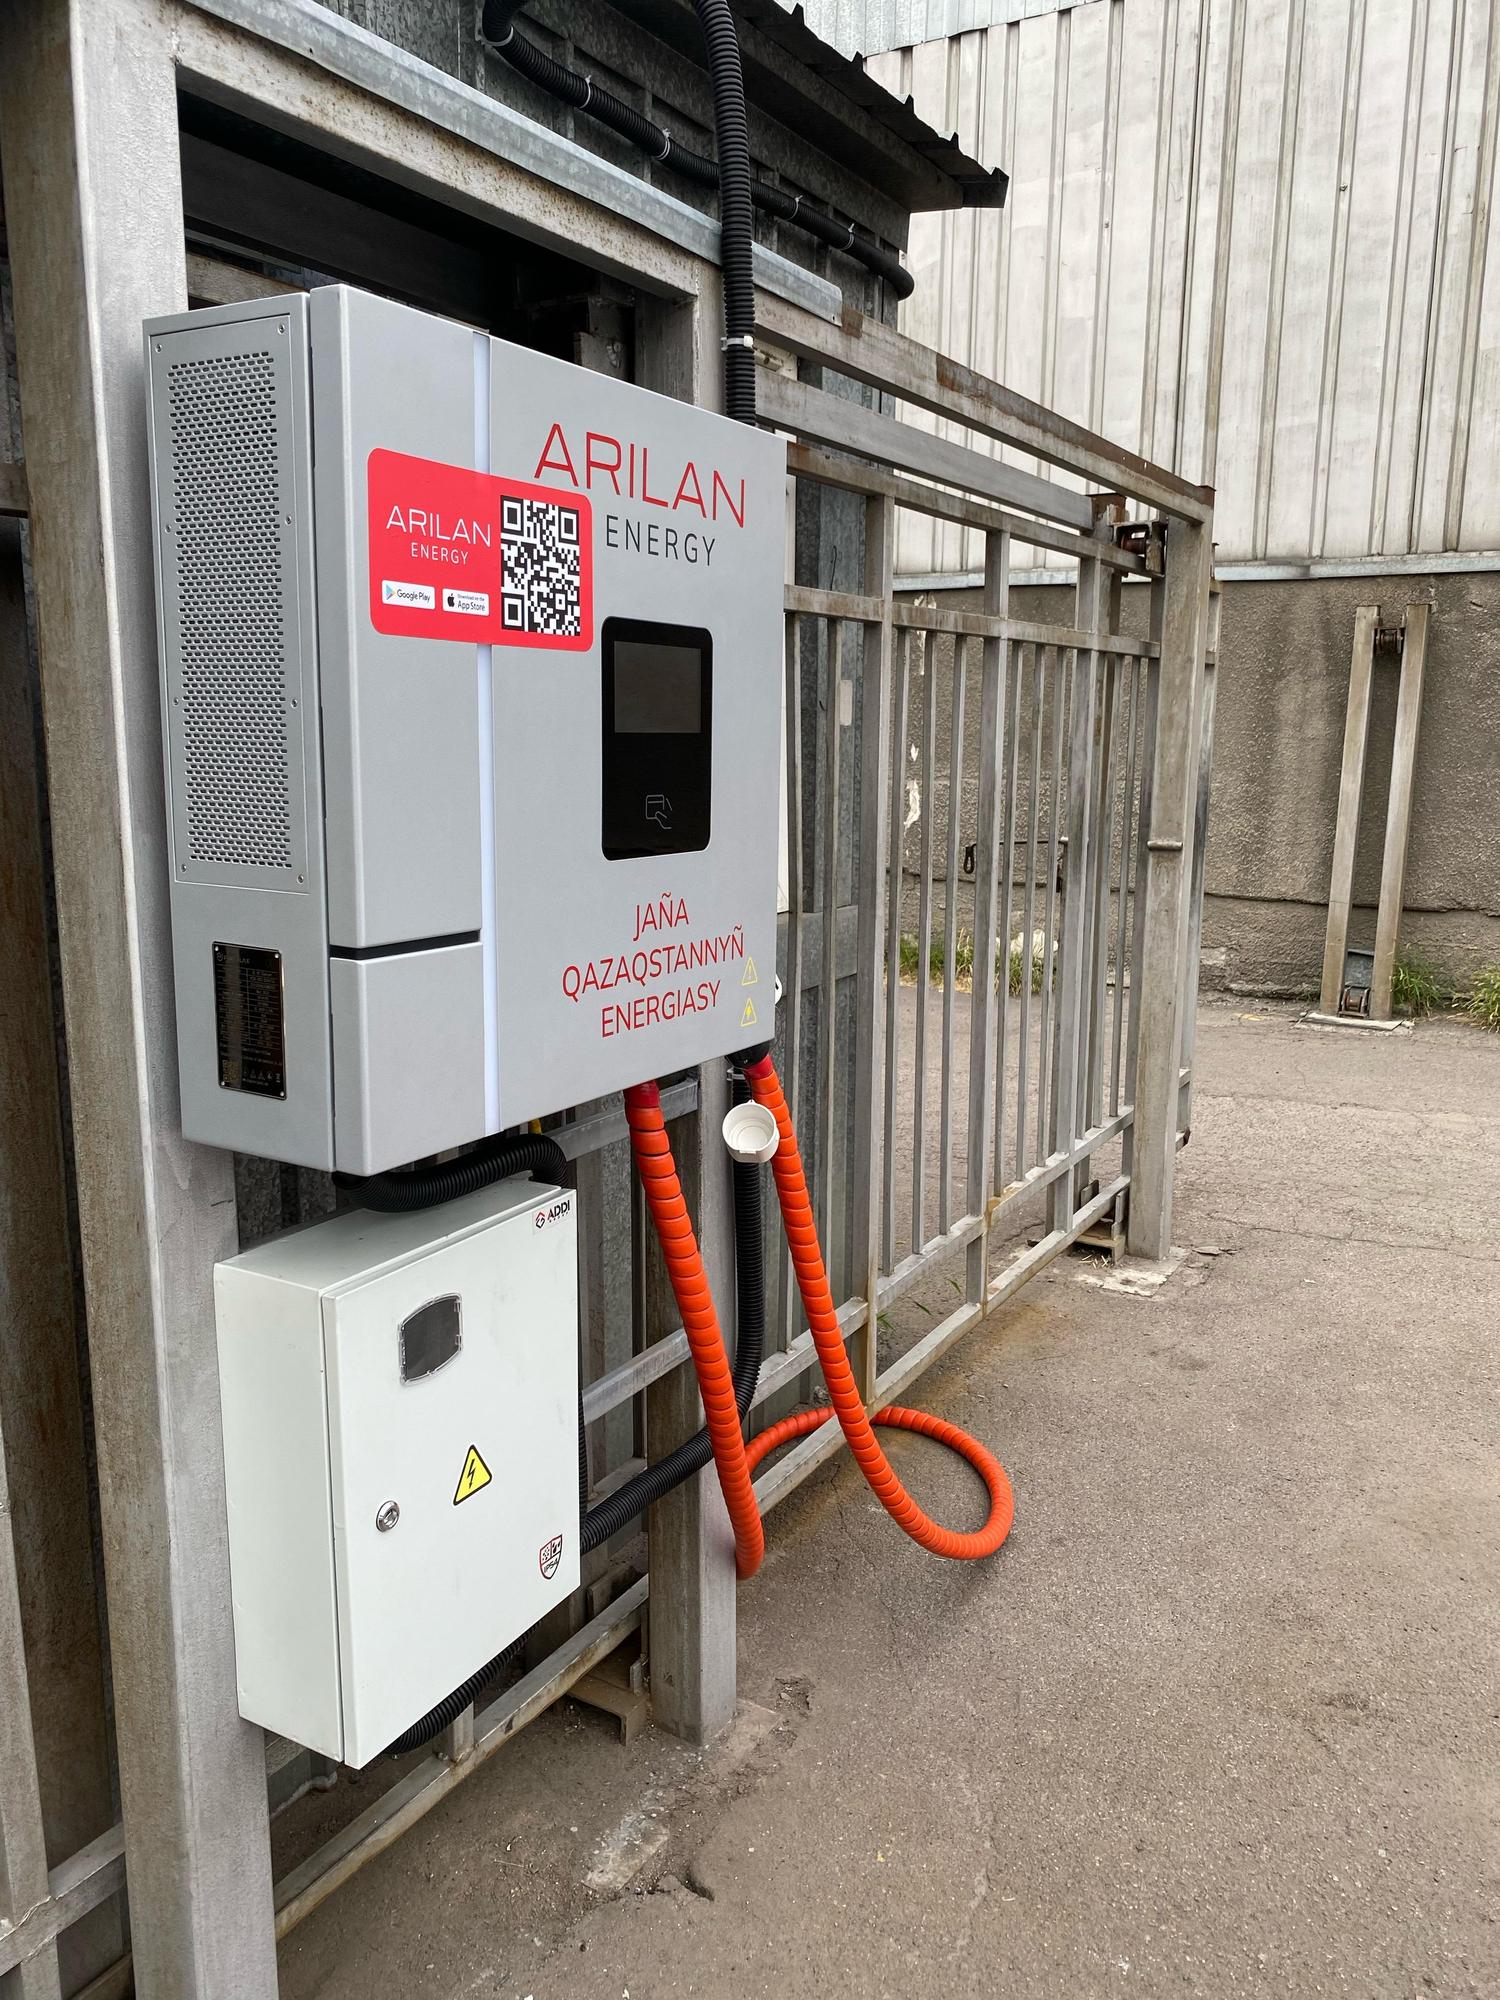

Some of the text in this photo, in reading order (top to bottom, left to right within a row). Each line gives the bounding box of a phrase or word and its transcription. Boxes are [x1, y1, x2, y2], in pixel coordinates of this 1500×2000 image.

[534, 423, 745, 528] ARILAN
[386, 505, 491, 548] ARILAN
[606, 514, 716, 567] ENERGY
[411, 542, 469, 565] ENERGY
[396, 589, 431, 603] Google Play
[457, 601, 486, 612] App Store
[633, 892, 689, 942] JAÑA
[562, 924, 744, 1003] QAZAQSTANNYÑ
[601, 980, 721, 1038] ENERGIASY
[547, 1199, 570, 1220] ADDI
